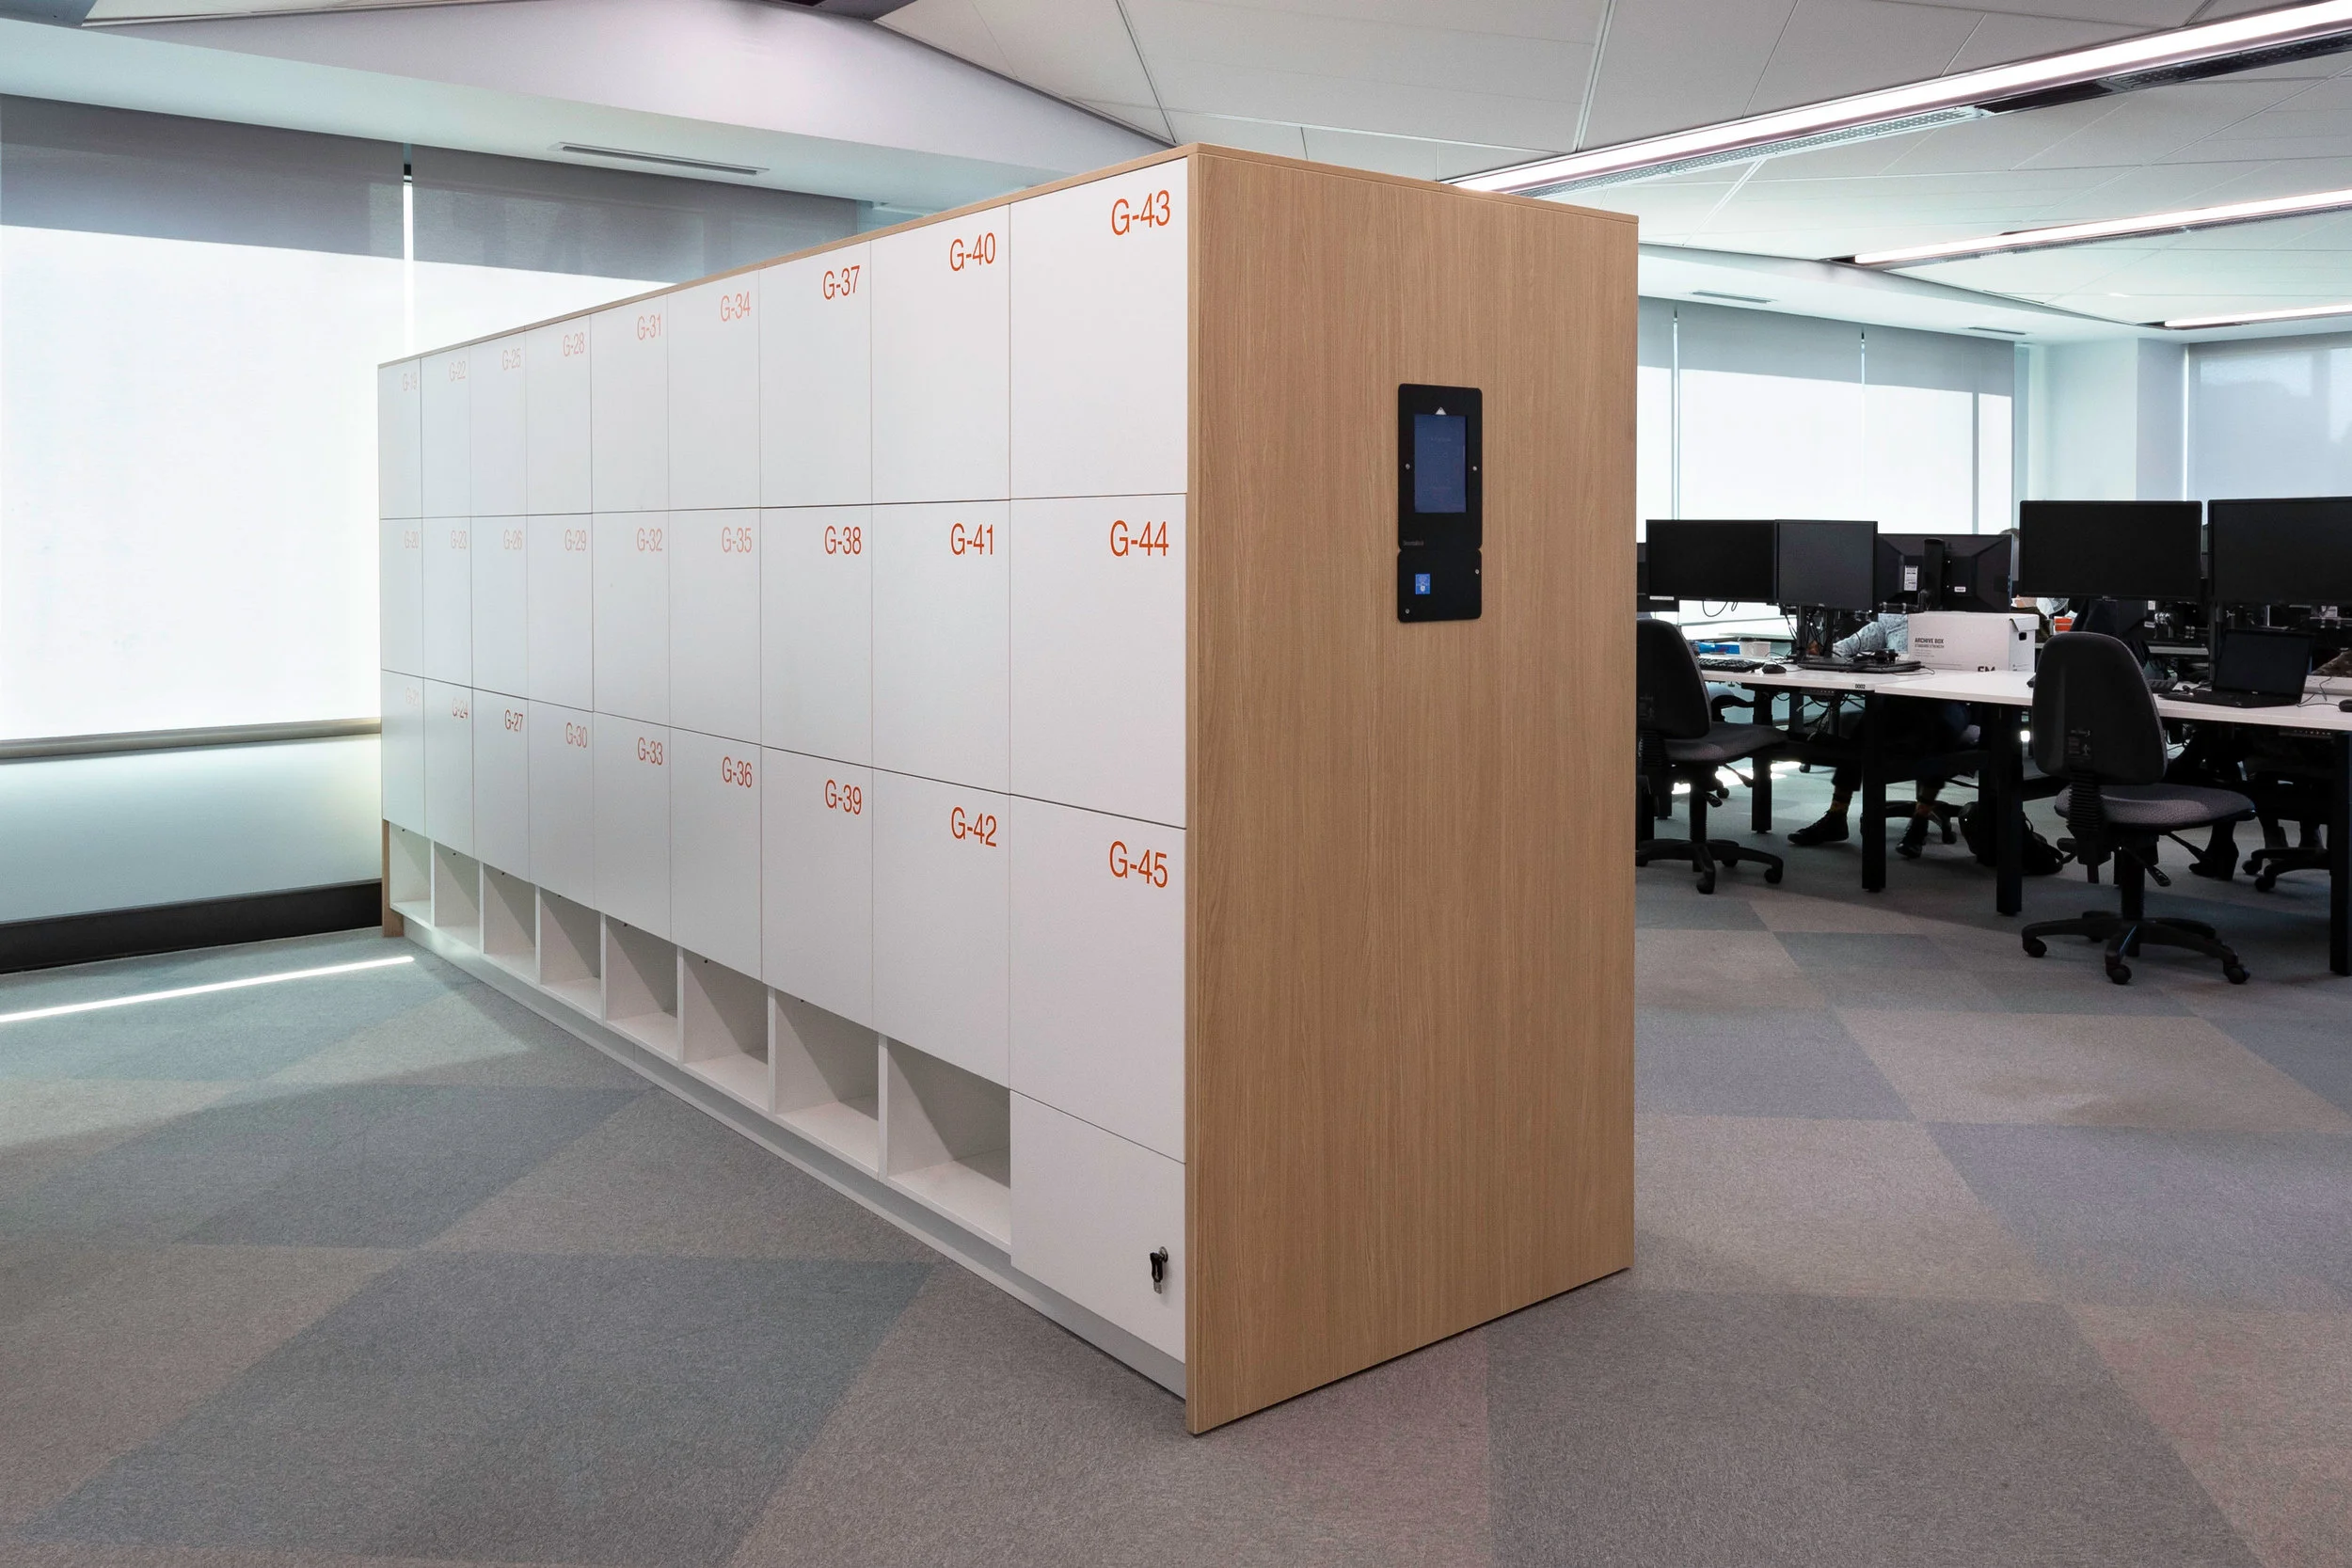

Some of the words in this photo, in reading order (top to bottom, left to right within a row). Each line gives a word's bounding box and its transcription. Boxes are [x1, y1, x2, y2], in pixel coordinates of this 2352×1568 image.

[1111, 190, 1170, 235] G-43
[949, 232, 996, 271] G-40
[823, 265, 860, 300] G-37
[720, 292, 751, 322] G-34
[637, 313, 662, 341] G-31
[563, 332, 585, 357] G-28
[449, 360, 466, 382] G-22
[502, 348, 521, 371] G-25
[405, 531, 419, 549] G-20
[451, 531, 467, 549] G-23
[503, 531, 522, 550] G-26
[564, 530, 586, 551] G-29
[637, 529, 662, 552] G-32
[722, 527, 752, 553] G-35
[824, 526, 862, 555] G-38
[950, 523, 994, 556] G-41
[1110, 520, 1169, 557] G-44
[452, 698, 469, 720] G-24
[504, 710, 523, 733] G-27
[565, 722, 588, 748] G-30
[638, 737, 663, 766] G-33
[722, 757, 753, 788] G-36
[824, 779, 862, 815] G-39
[950, 807, 997, 847] G-42
[1109, 841, 1168, 888] G-45
